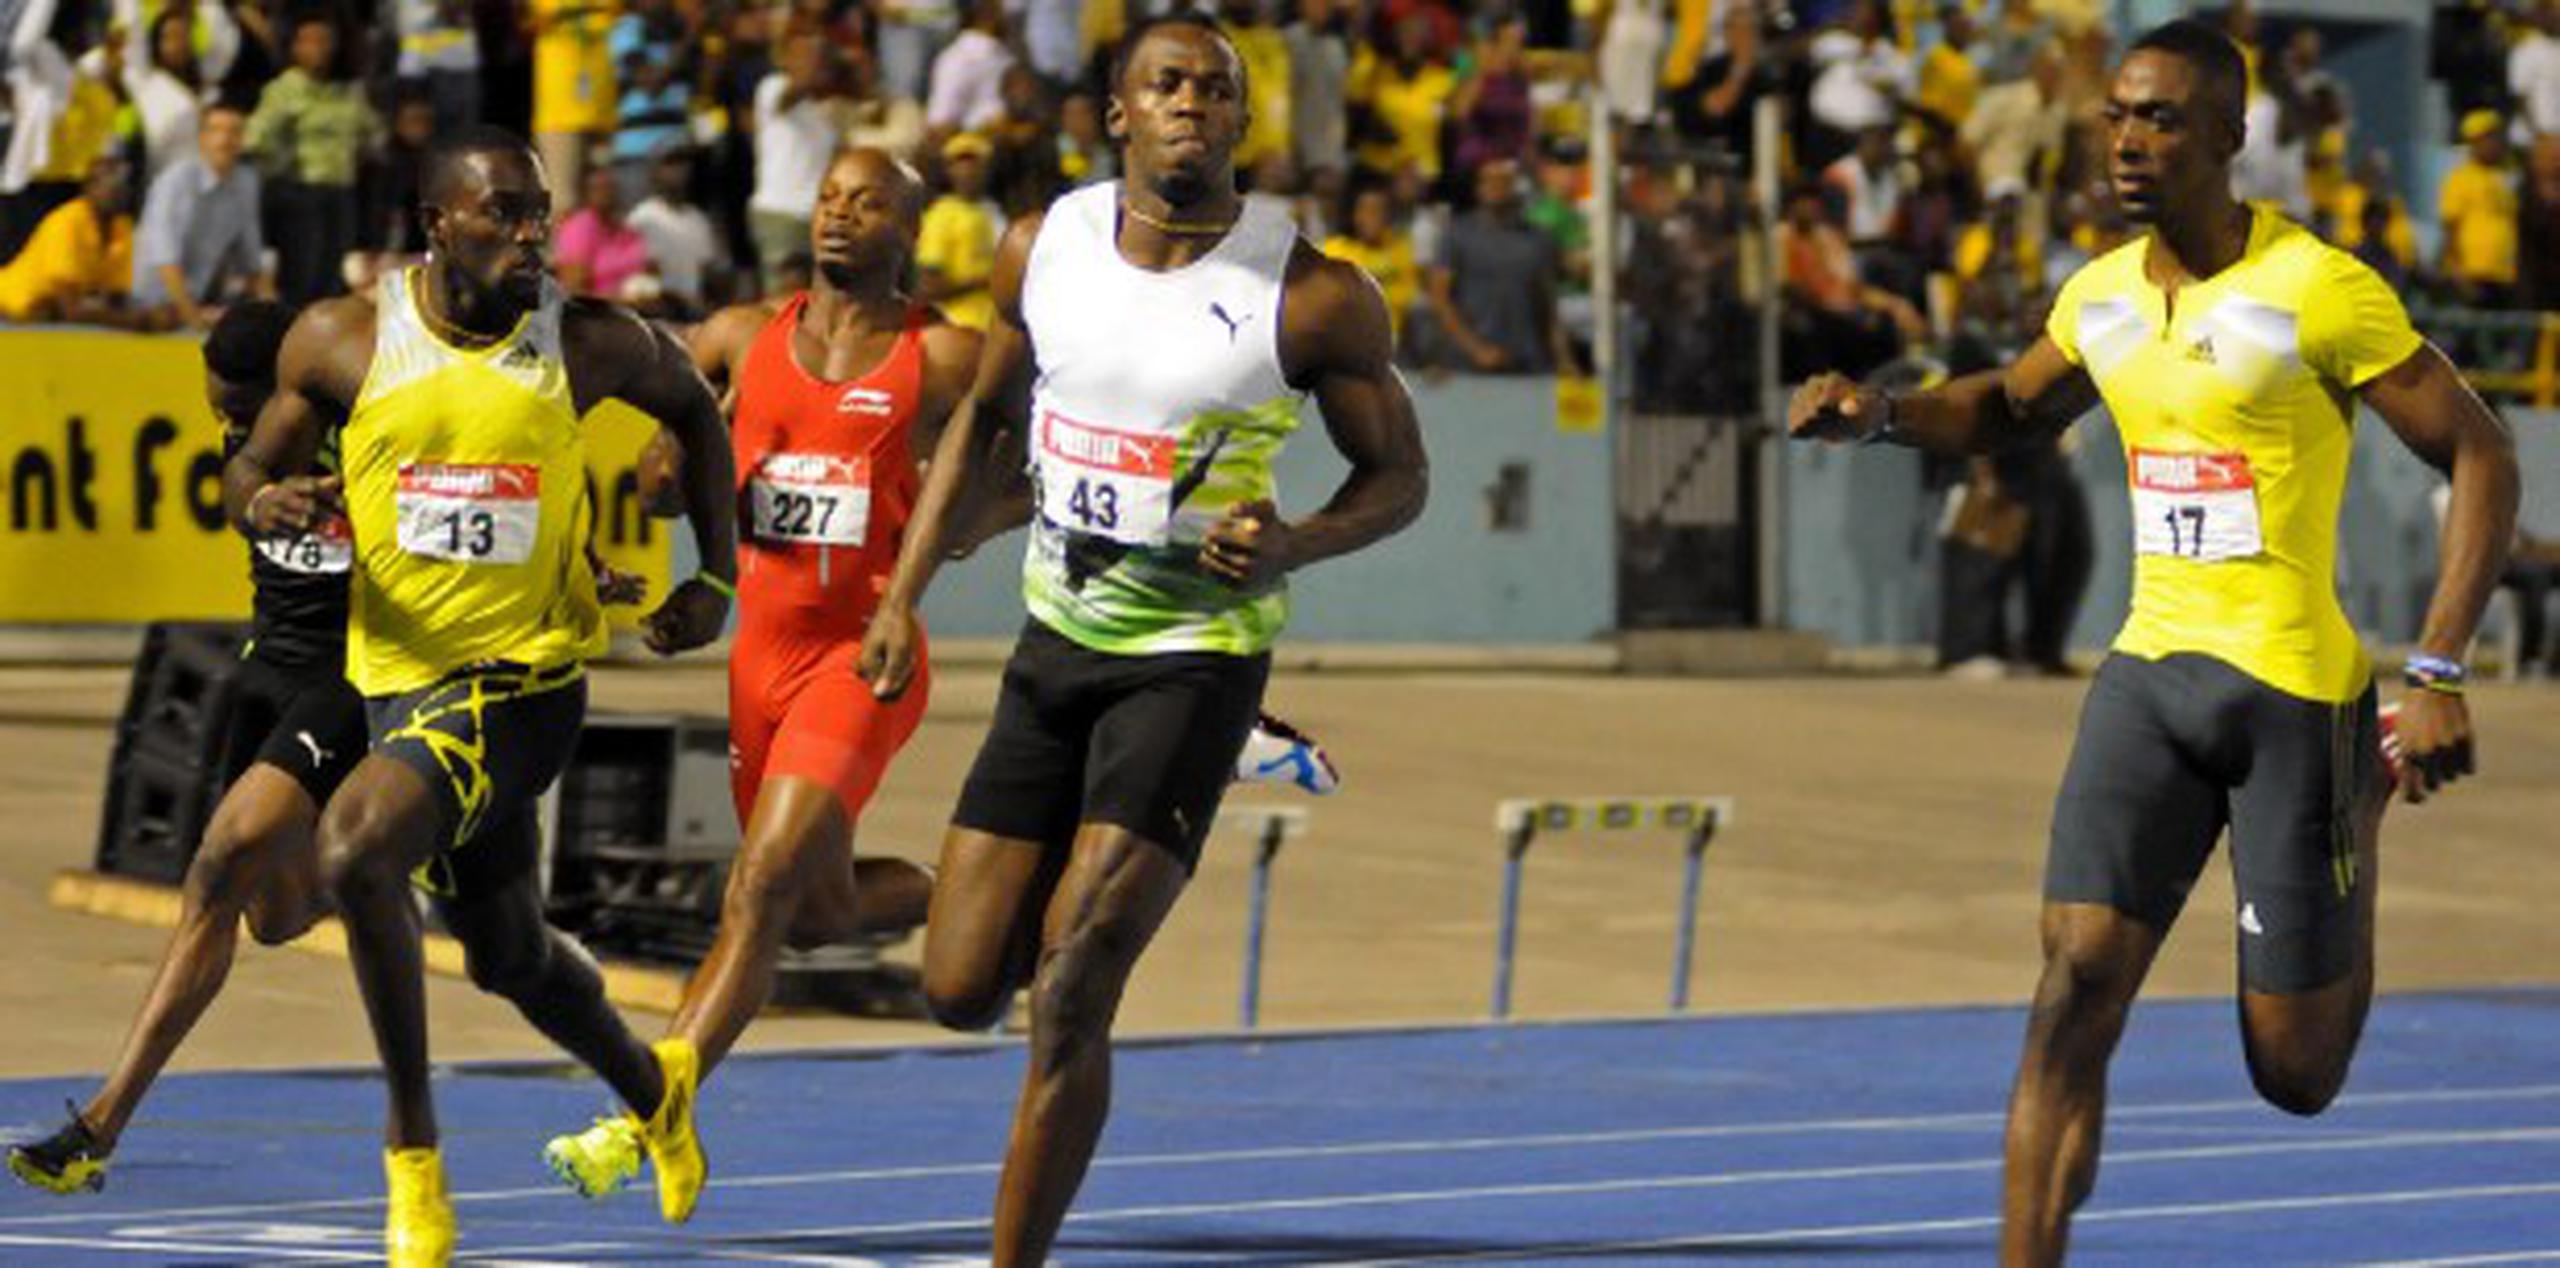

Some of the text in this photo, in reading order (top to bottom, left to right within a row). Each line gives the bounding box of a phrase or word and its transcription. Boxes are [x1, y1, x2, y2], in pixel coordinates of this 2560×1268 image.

[771, 491, 839, 537] 227
[1067, 478, 1119, 529] 43
[443, 508, 495, 557] 13
[2165, 505, 2206, 557] 17
